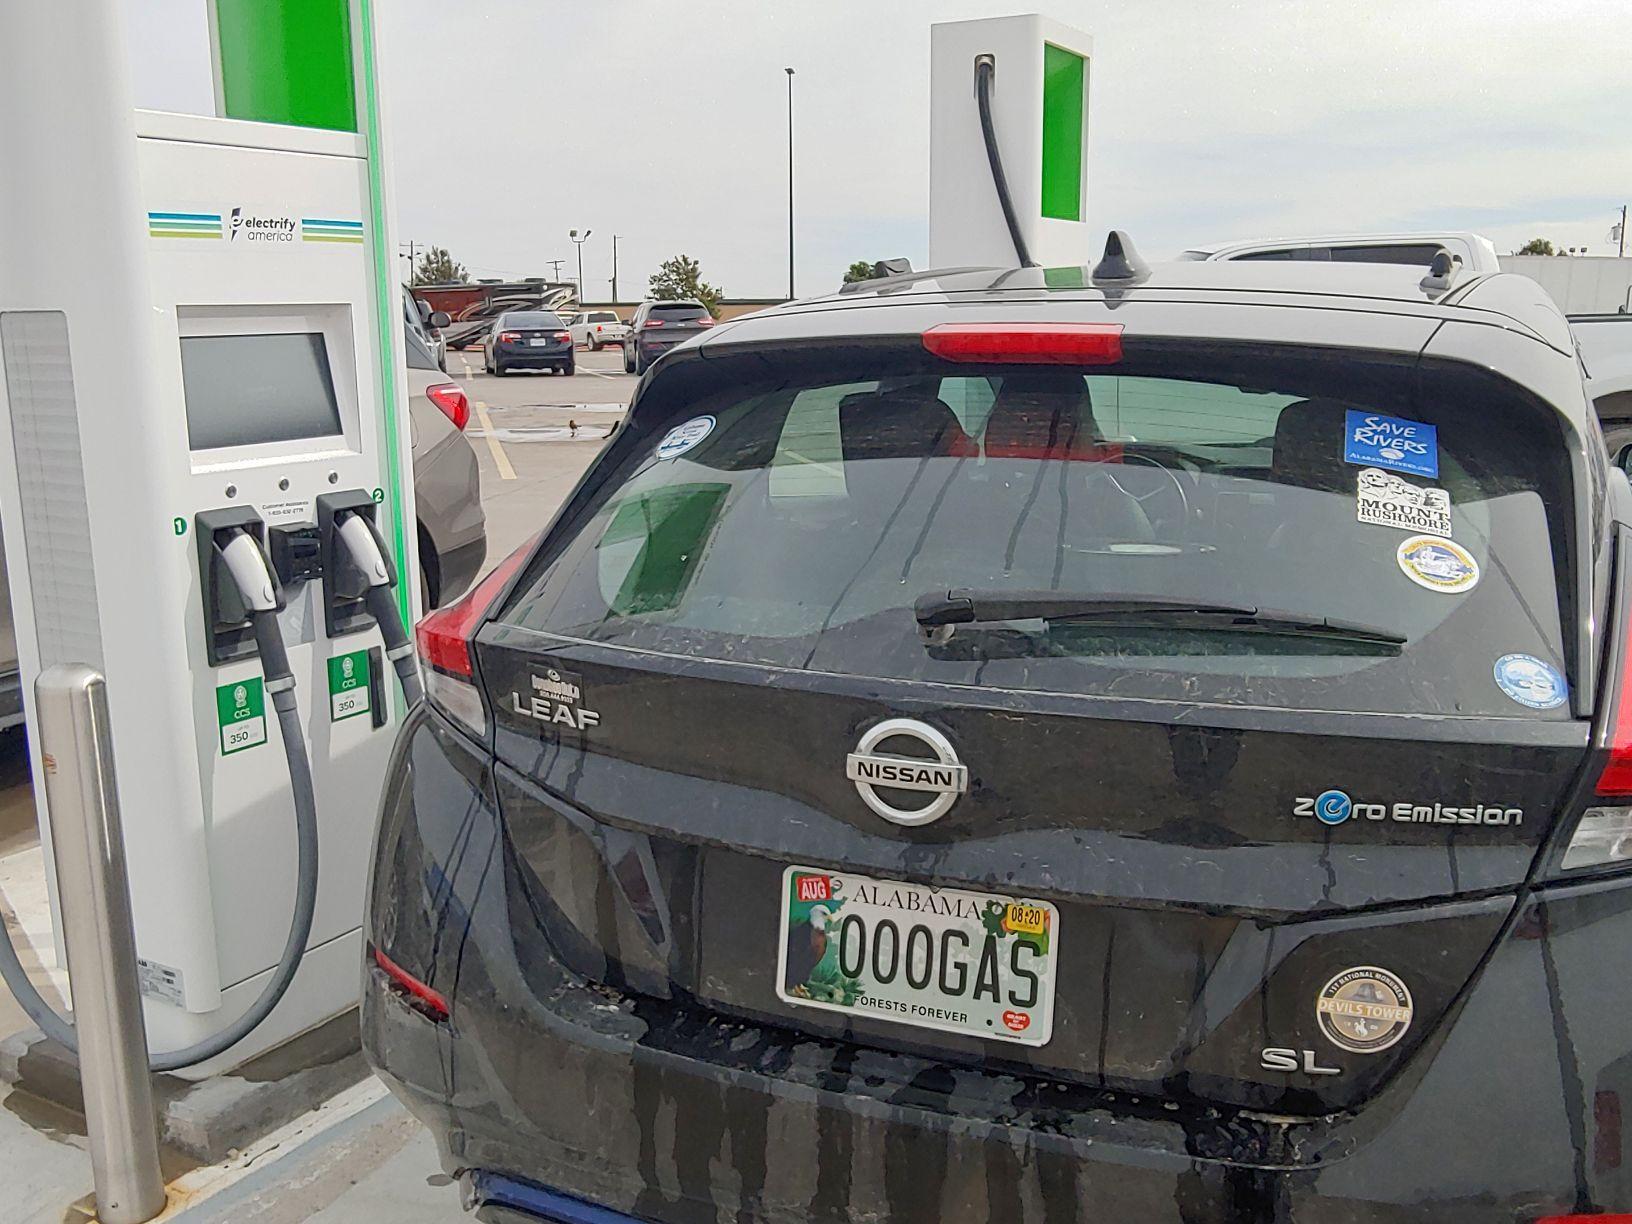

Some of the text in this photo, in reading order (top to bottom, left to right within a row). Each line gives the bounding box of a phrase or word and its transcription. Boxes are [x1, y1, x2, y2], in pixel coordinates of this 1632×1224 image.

[245, 217, 296, 232] electrify
[247, 231, 293, 242] america
[1362, 416, 1417, 438] SAVE
[1353, 427, 1429, 454] RIVERS
[1360, 498, 1449, 521] MOUNT
[1360, 507, 1450, 531] RUSHMORE
[341, 678, 357, 689] CCS
[234, 707, 251, 720] CCS
[338, 700, 355, 712] 350
[512, 691, 600, 730] LEAF
[230, 731, 249, 745] 350
[857, 761, 952, 787] NISSAN
[1392, 802, 1523, 827] Emission
[801, 880, 827, 900] AUG
[852, 884, 982, 921] ALABAMA
[1339, 970, 1374, 985] NATIONAL
[1374, 971, 1406, 1002] MONUMENT
[854, 994, 968, 1024] FORESTS FOREVER
[1319, 1000, 1411, 1020] DEVILS TOWER
[1260, 1047, 1342, 1076] SL
